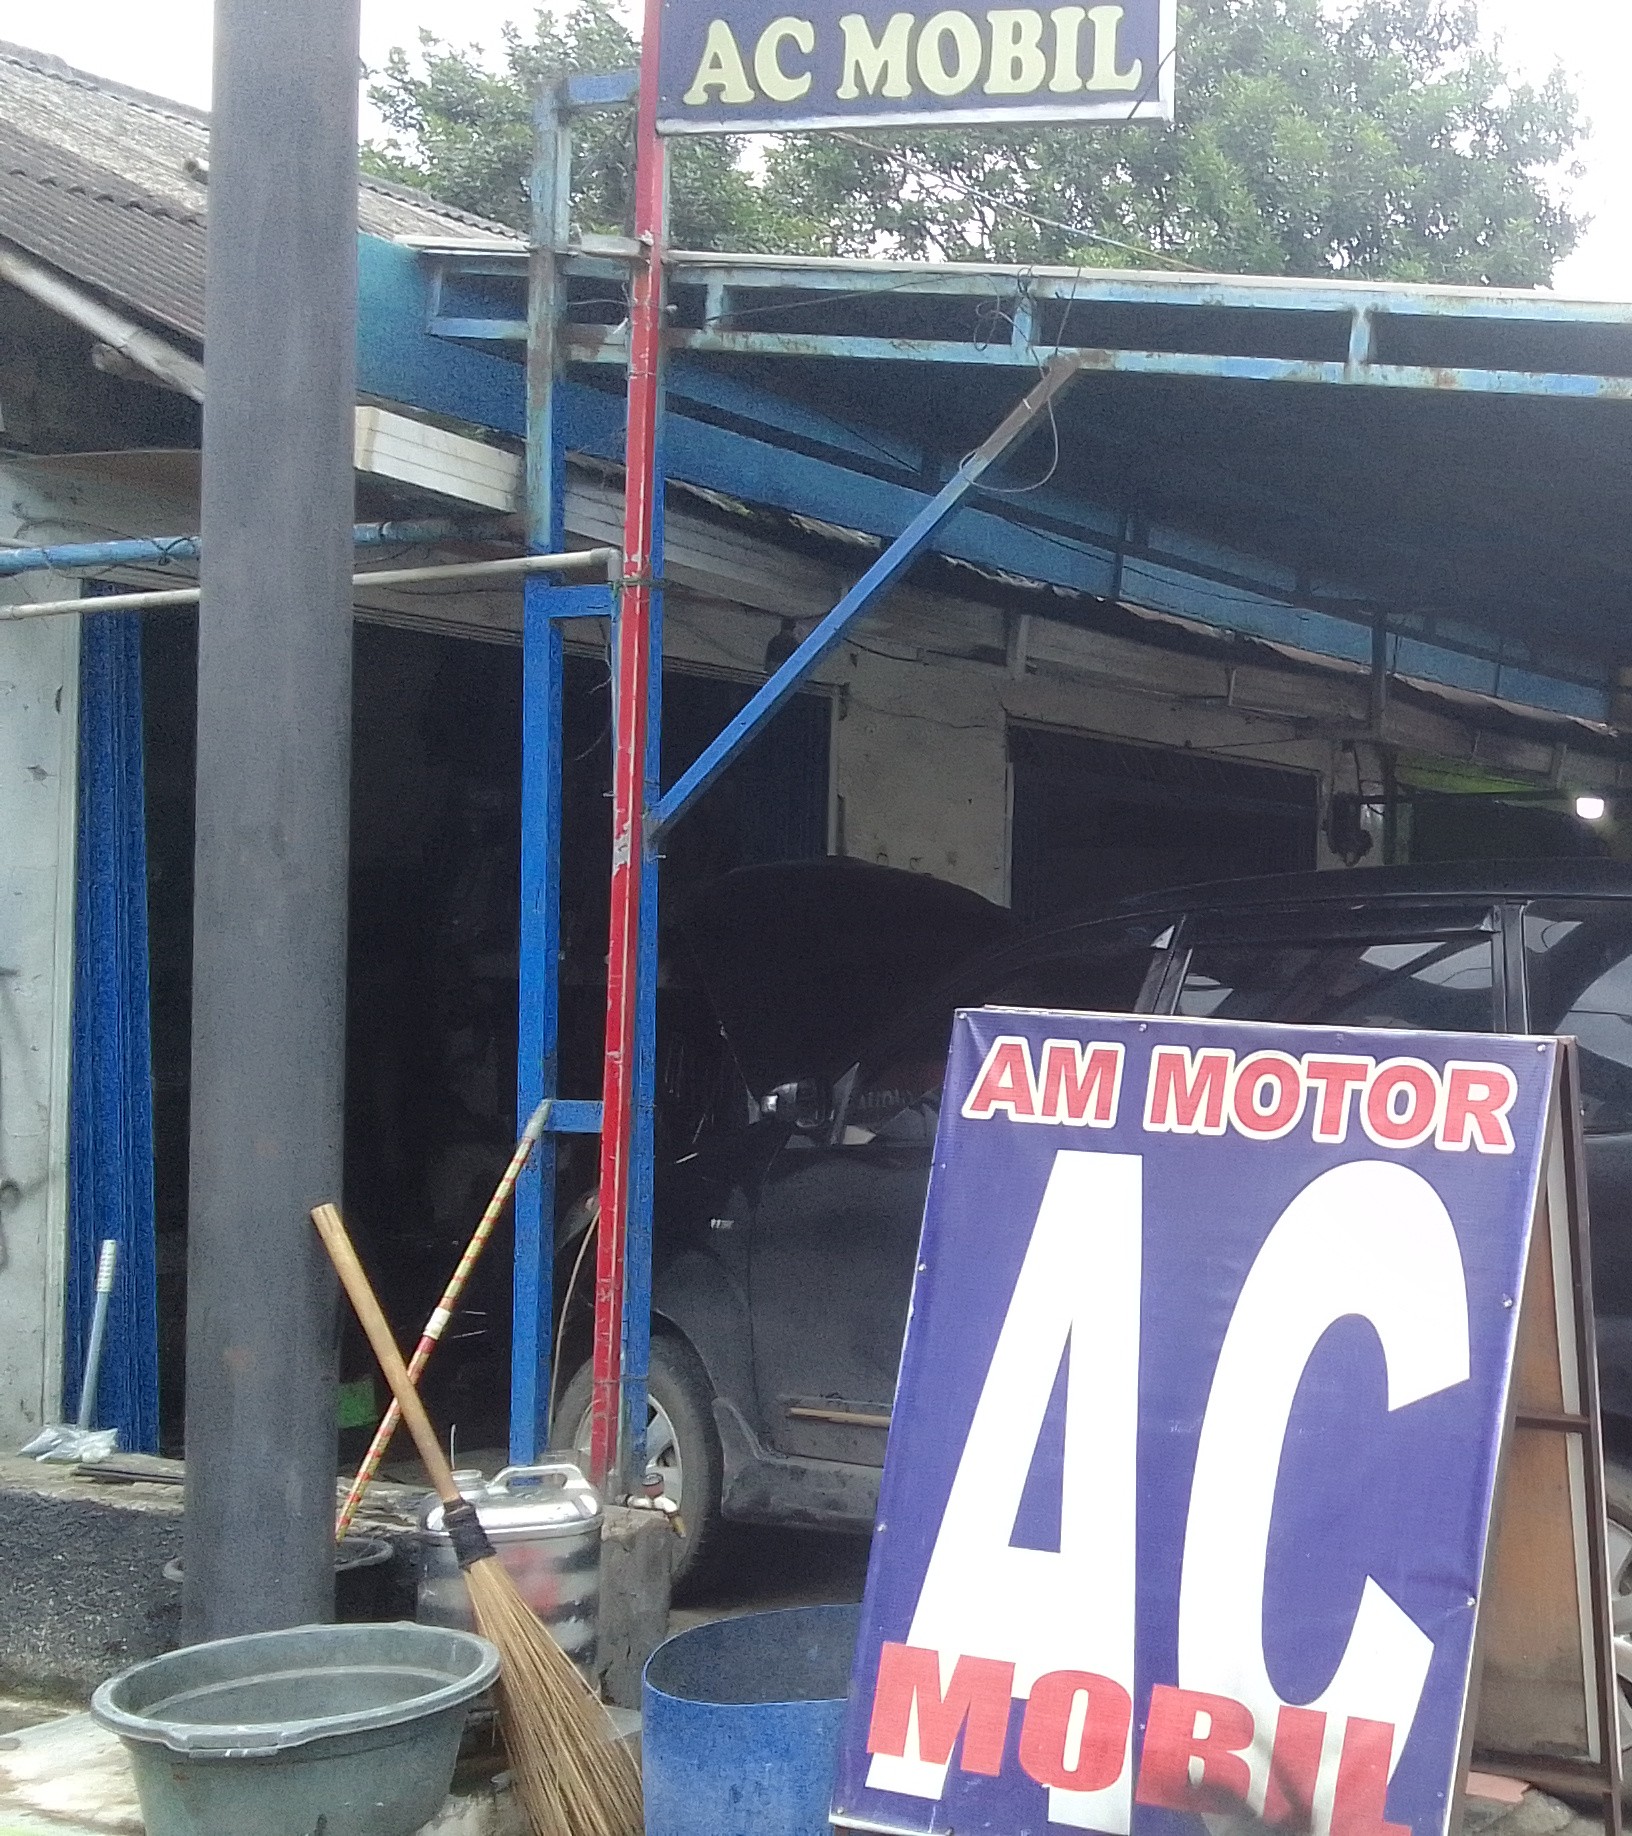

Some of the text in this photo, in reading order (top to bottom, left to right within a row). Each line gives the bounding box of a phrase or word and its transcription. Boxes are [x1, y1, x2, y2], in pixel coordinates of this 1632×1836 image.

[683, 6, 1142, 105] AC MOBIL
[963, 1036, 1518, 1154] AM MOTOR
[865, 1149, 1470, 1836] AC
[867, 1641, 1412, 1836] MOBIL
